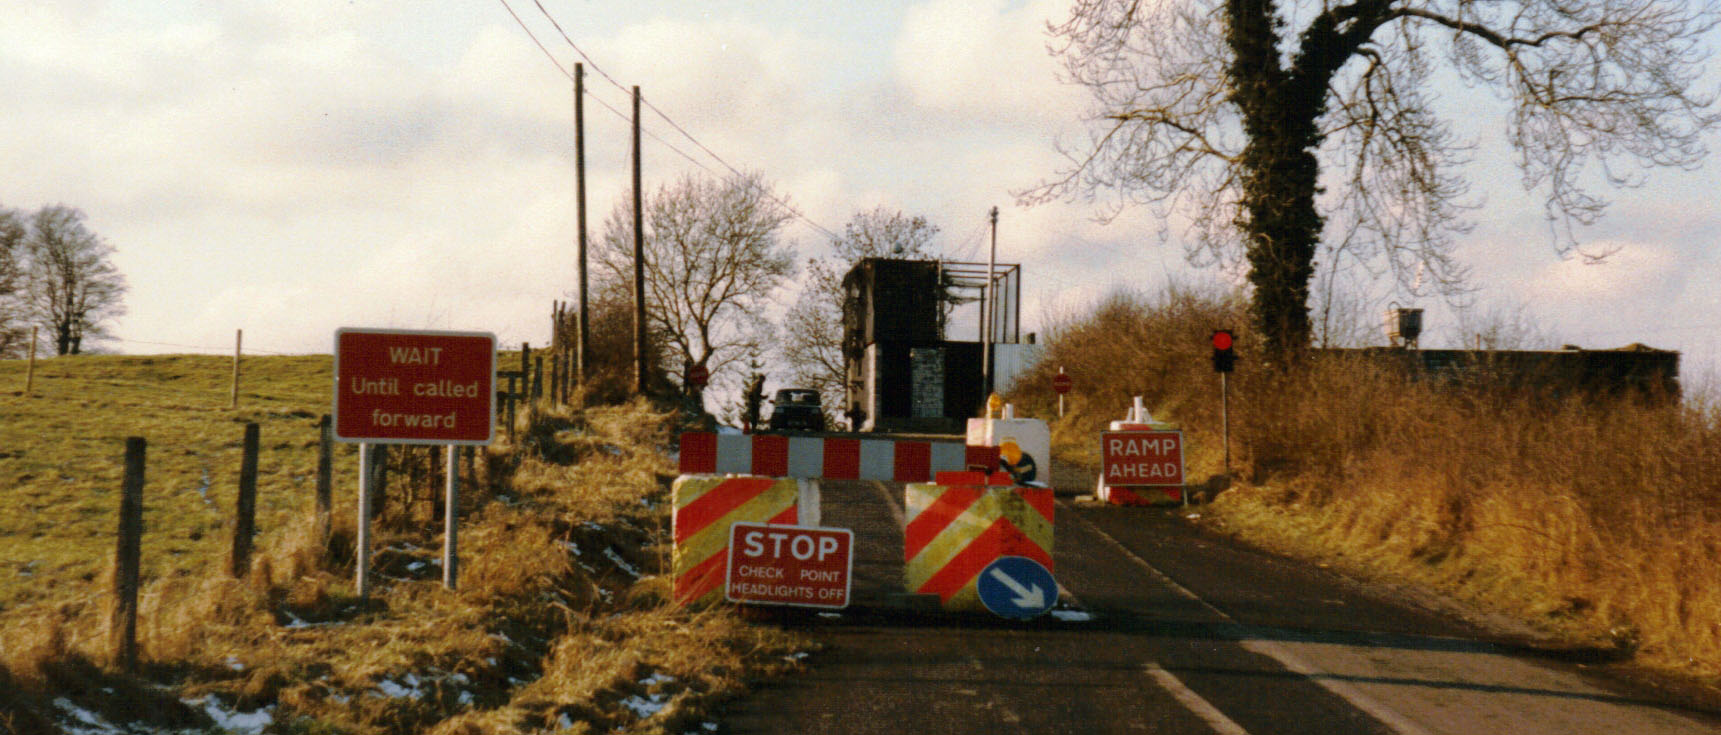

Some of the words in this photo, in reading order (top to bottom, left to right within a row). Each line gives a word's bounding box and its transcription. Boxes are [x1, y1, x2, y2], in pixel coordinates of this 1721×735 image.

[389, 346, 443, 365] WAIT
[351, 376, 400, 395] Until
[413, 379, 479, 398] called
[372, 408, 457, 428] forward
[1110, 439, 1176, 456] RAMP
[1109, 463, 1177, 478] AHEAD
[743, 531, 839, 561] STOP
[739, 565, 784, 579] CHECK
[800, 569, 841, 582] POINT
[731, 582, 814, 599] HEADLIGHTS
[818, 588, 844, 600] OFF
